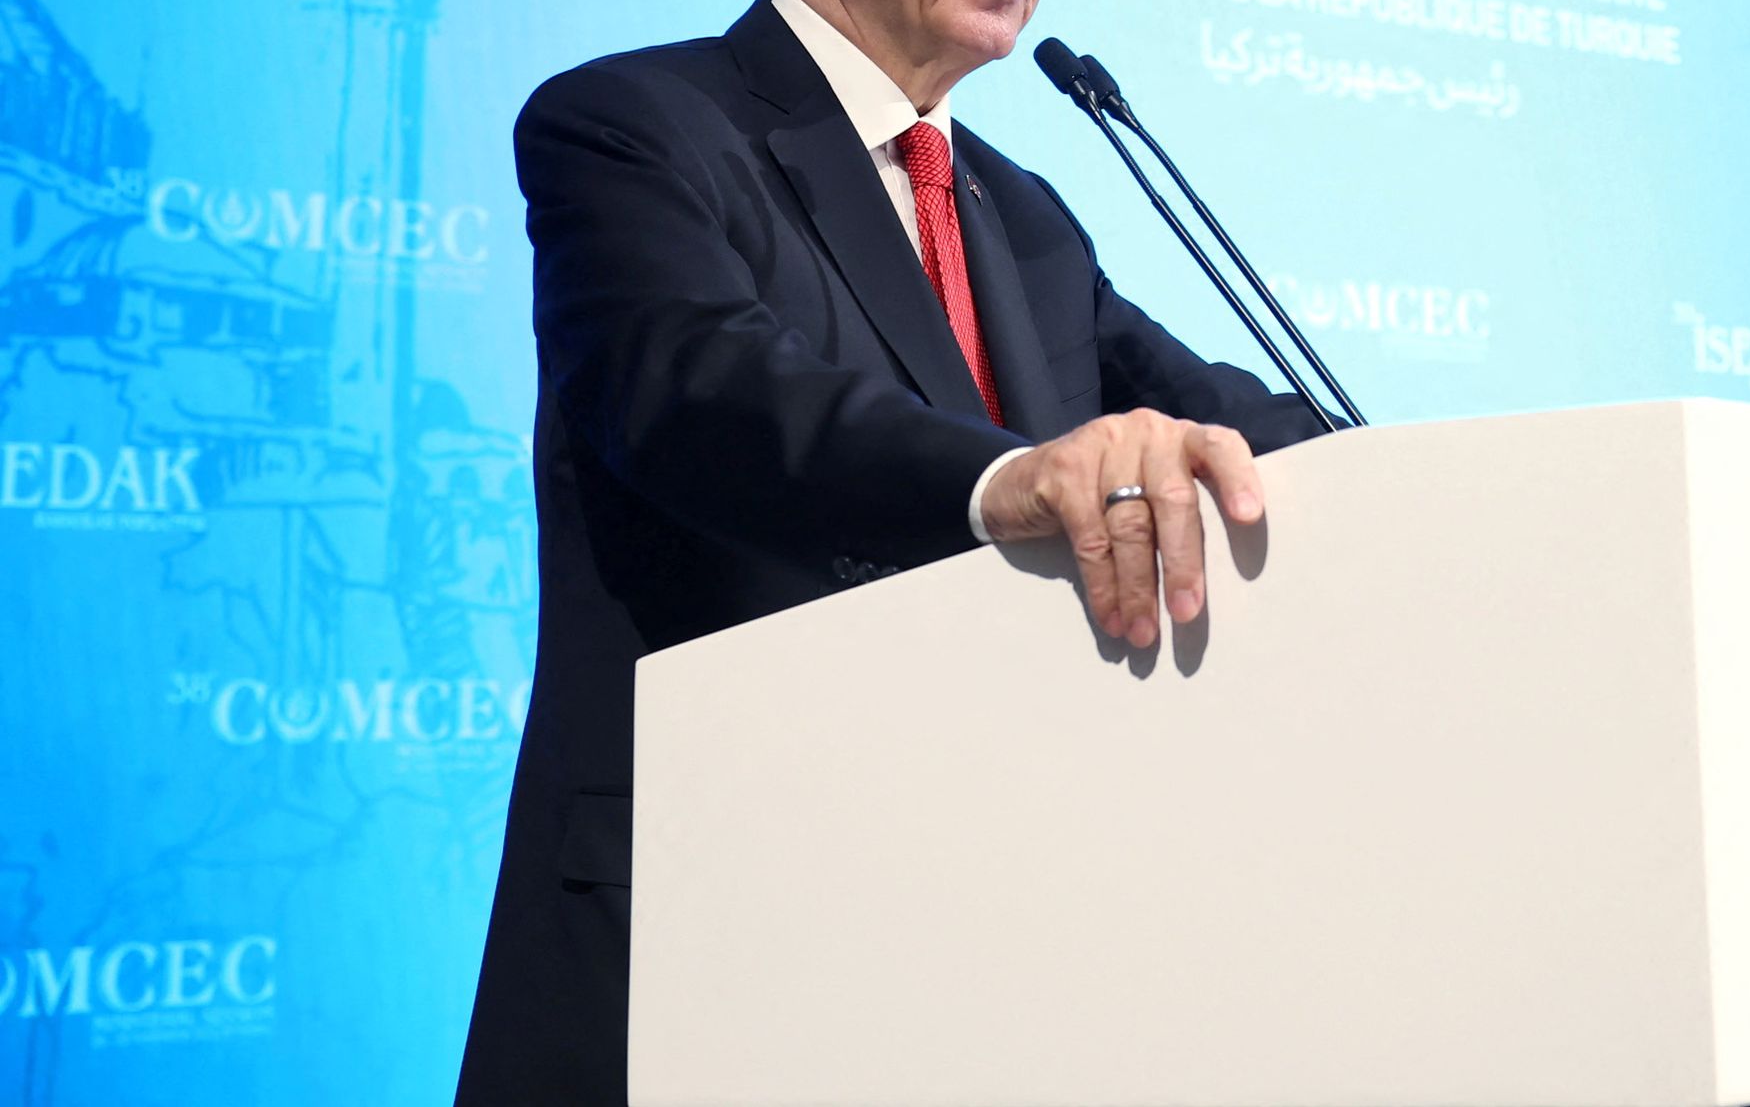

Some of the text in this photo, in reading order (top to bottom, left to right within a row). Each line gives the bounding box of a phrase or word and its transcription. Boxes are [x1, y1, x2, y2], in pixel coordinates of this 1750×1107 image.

[1508, 1, 1553, 47] DE
[1555, 8, 1682, 65] TURQUIE
[150, 177, 490, 266] COMCEC
[0, 441, 201, 510] EDAK
